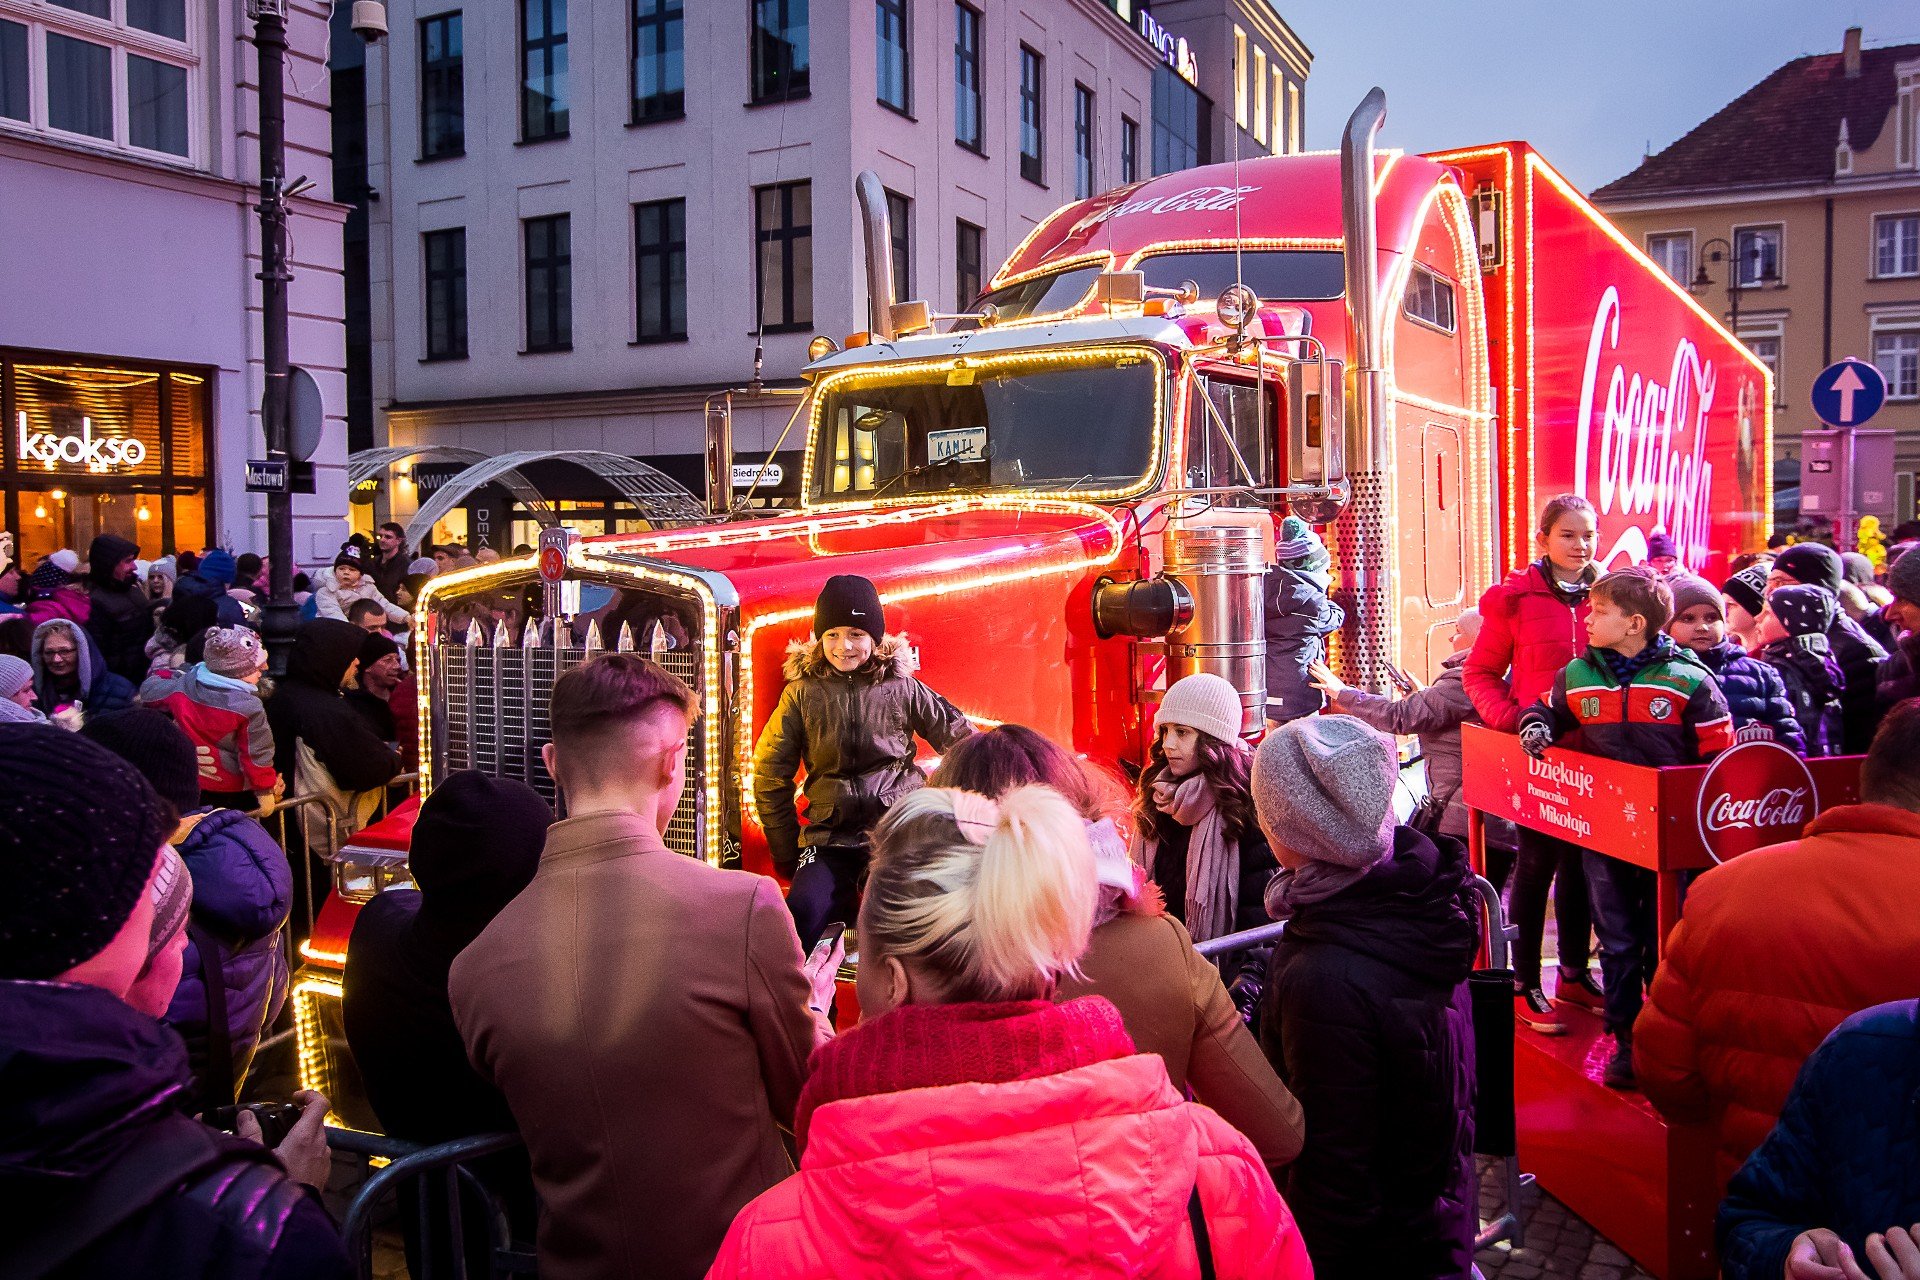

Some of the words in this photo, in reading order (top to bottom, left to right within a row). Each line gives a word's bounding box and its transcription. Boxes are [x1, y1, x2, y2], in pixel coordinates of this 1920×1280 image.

[1140, 8, 1176, 68] ING
[19, 410, 146, 466] ksokso
[937, 438, 976, 457] KAMIL
[1574, 285, 1717, 570] Coca-Cola
[733, 467, 780, 477] Biedronka
[477, 508, 490, 551] DEK
[1528, 756, 1594, 799] Dziękuję
[1539, 801, 1592, 838] Mikołaja
[1706, 787, 1809, 832] Coca-Cola
